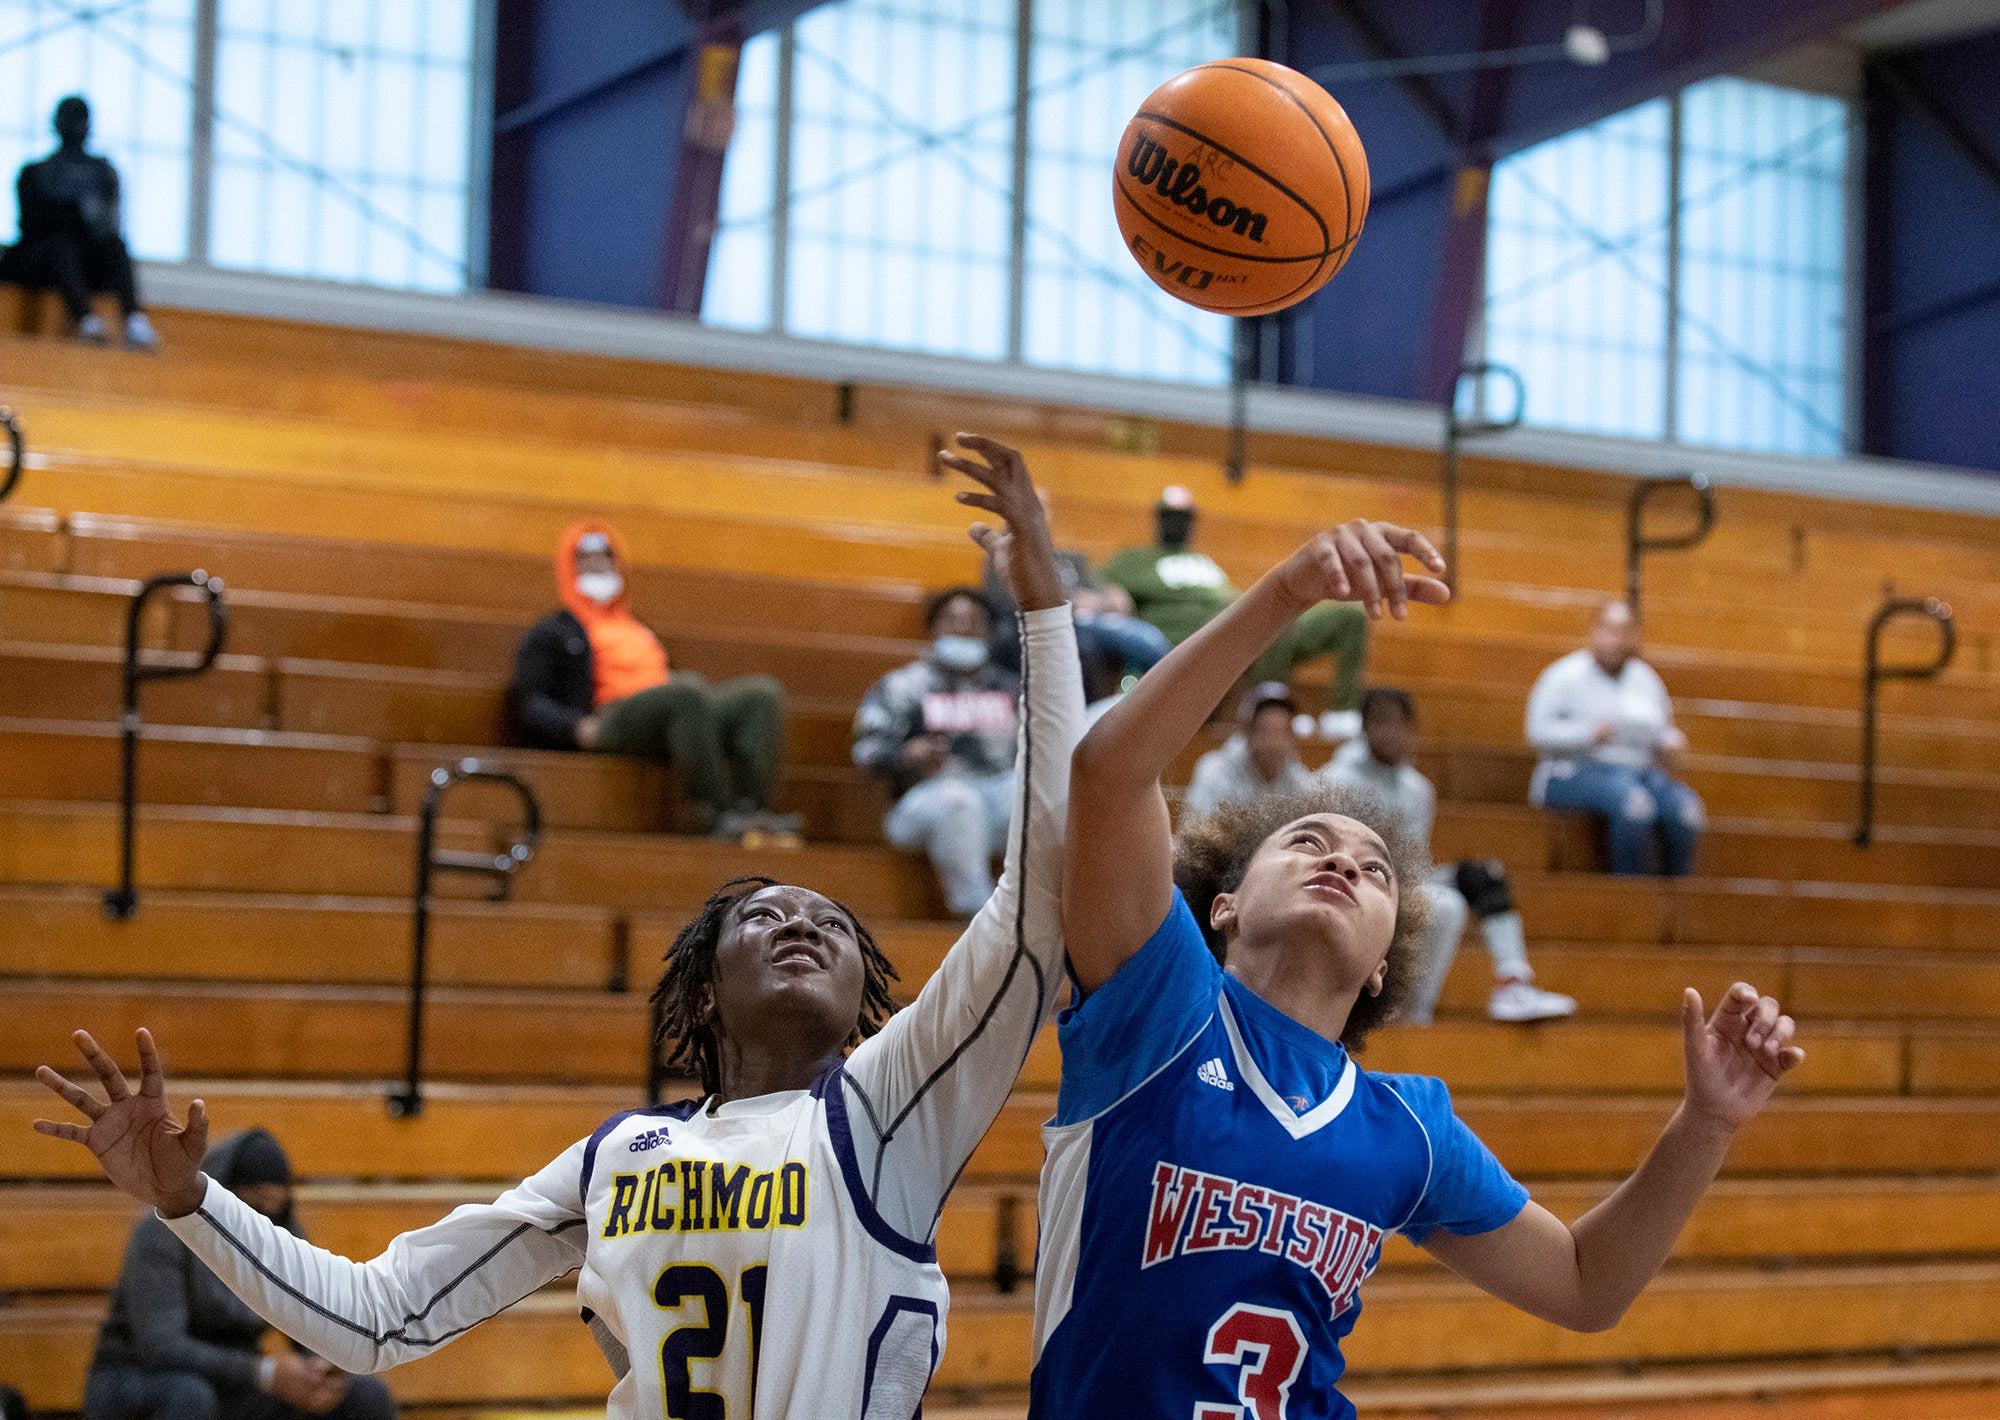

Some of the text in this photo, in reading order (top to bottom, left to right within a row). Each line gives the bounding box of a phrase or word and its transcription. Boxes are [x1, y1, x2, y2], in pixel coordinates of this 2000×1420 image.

[1128, 131, 1268, 243] Wilson
[1132, 233, 1214, 290] EVO
[1197, 1065, 1235, 1092] adidas
[628, 1135, 673, 1152] adidas
[1141, 1160, 1383, 1322] WESTSIDE
[1194, 1302, 1310, 1420] 3
